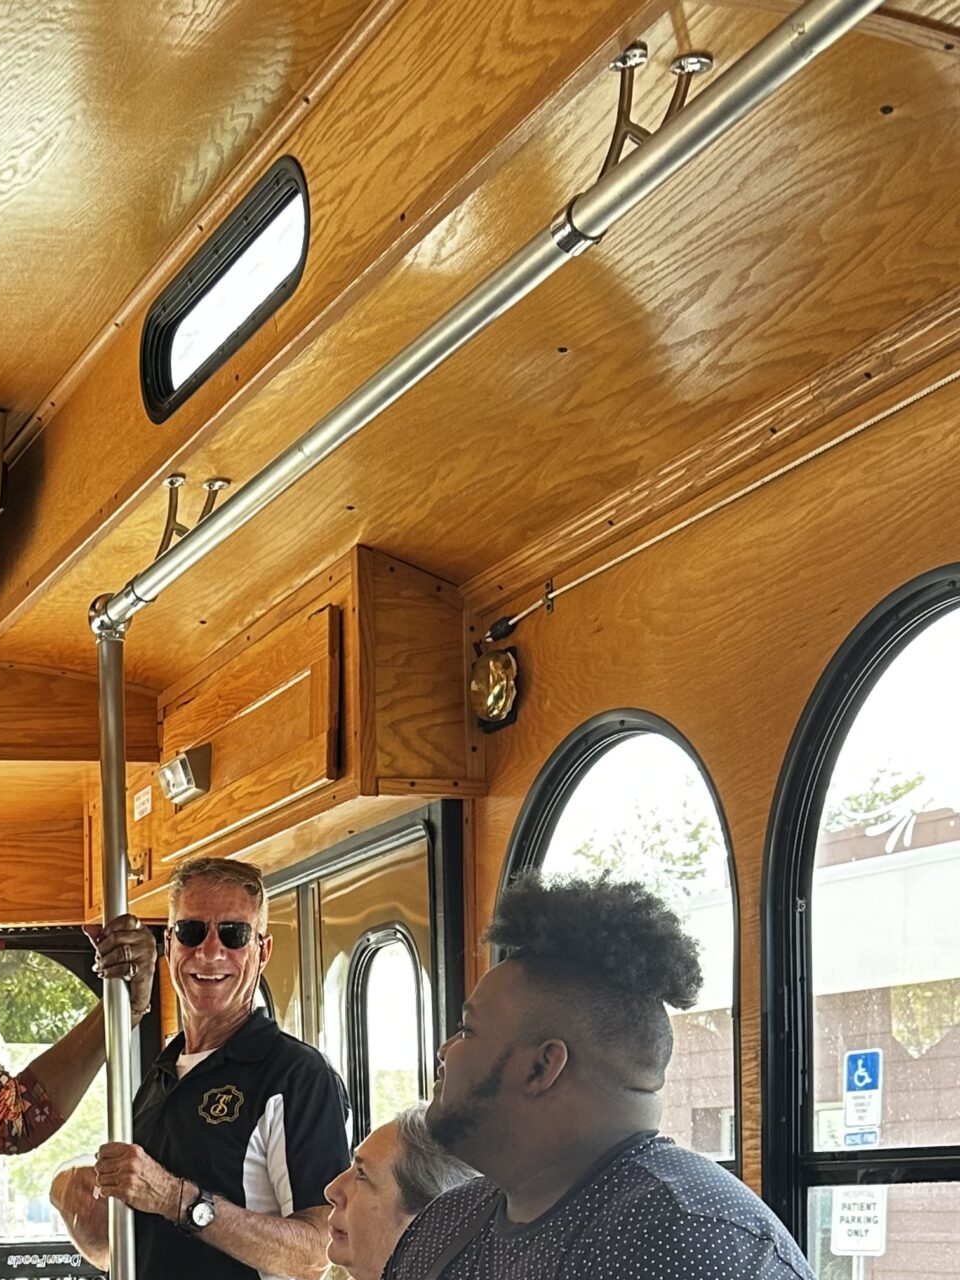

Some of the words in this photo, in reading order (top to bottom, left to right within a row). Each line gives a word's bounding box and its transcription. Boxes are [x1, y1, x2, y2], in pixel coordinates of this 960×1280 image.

[841, 1202, 878, 1212] PATIENT
[839, 1215, 879, 1225] PARKING
[847, 1228, 870, 1238] ONLY
